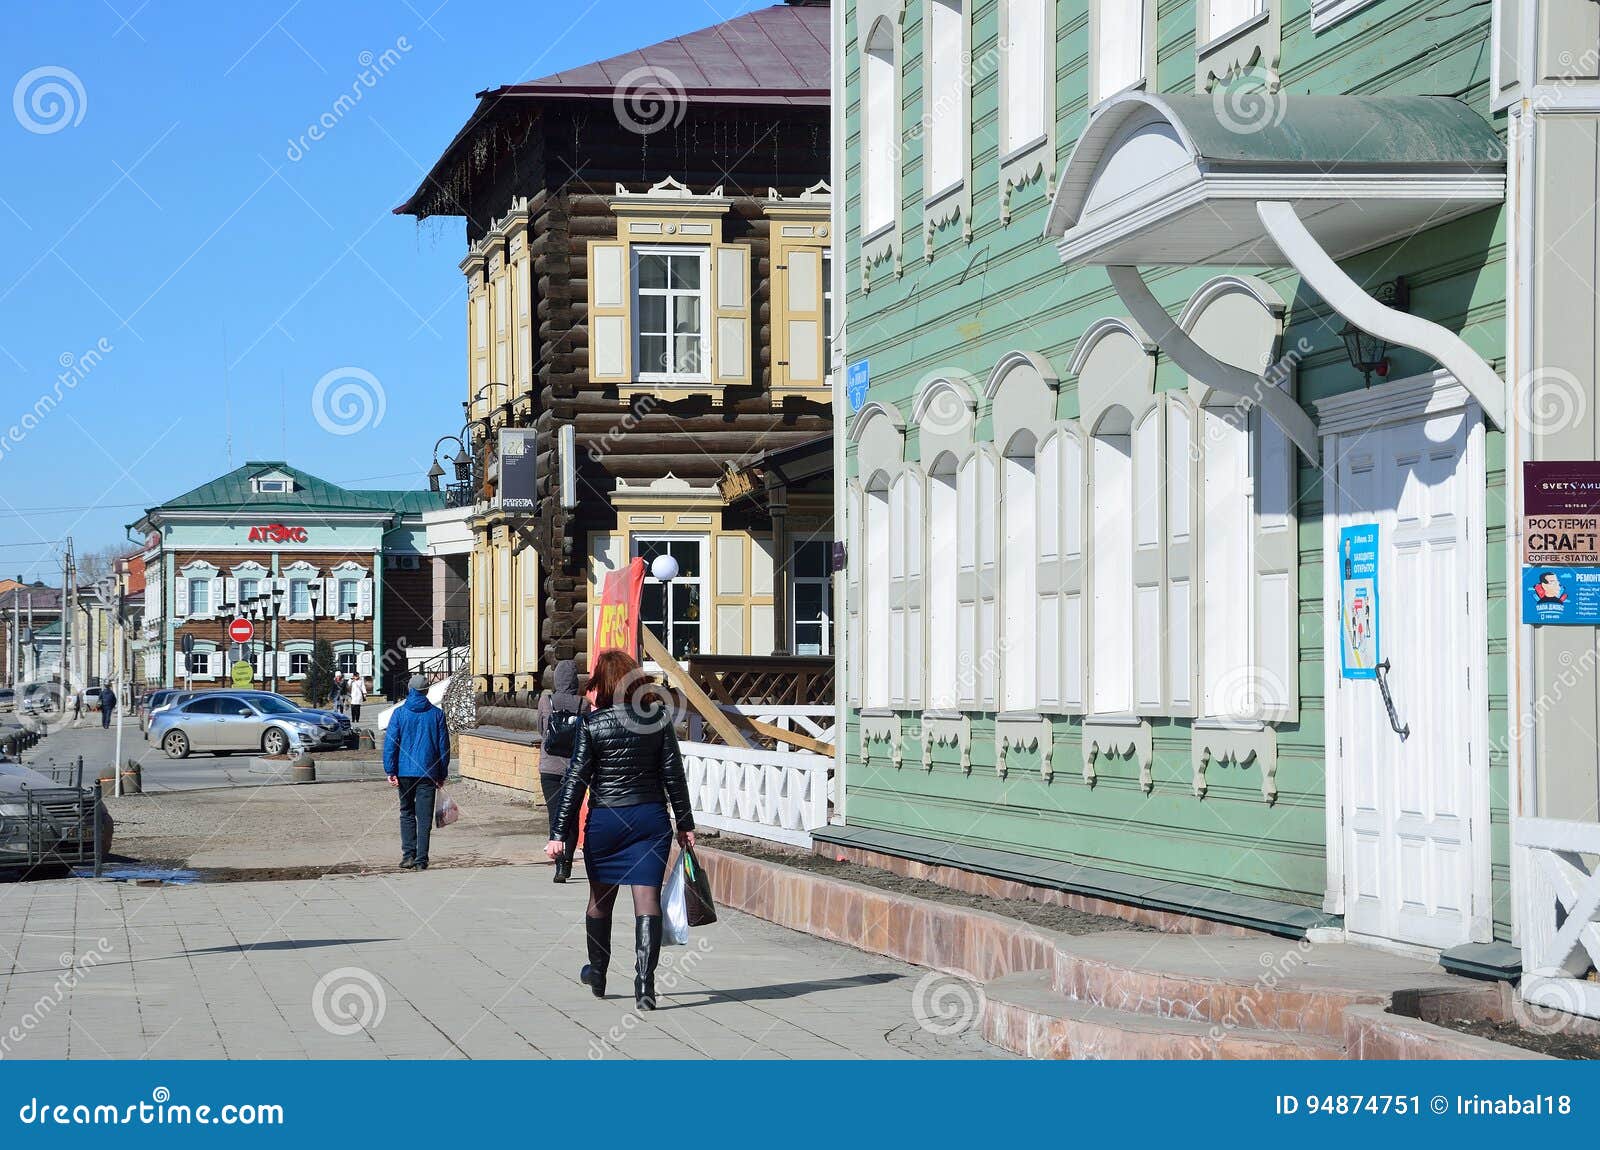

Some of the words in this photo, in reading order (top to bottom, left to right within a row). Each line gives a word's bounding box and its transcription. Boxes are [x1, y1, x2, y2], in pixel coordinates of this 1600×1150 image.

[1529, 518, 1597, 529] РОСТЕРИЯ
[248, 523, 308, 544] АТЭКС
[1528, 533, 1598, 551] CRAFT
